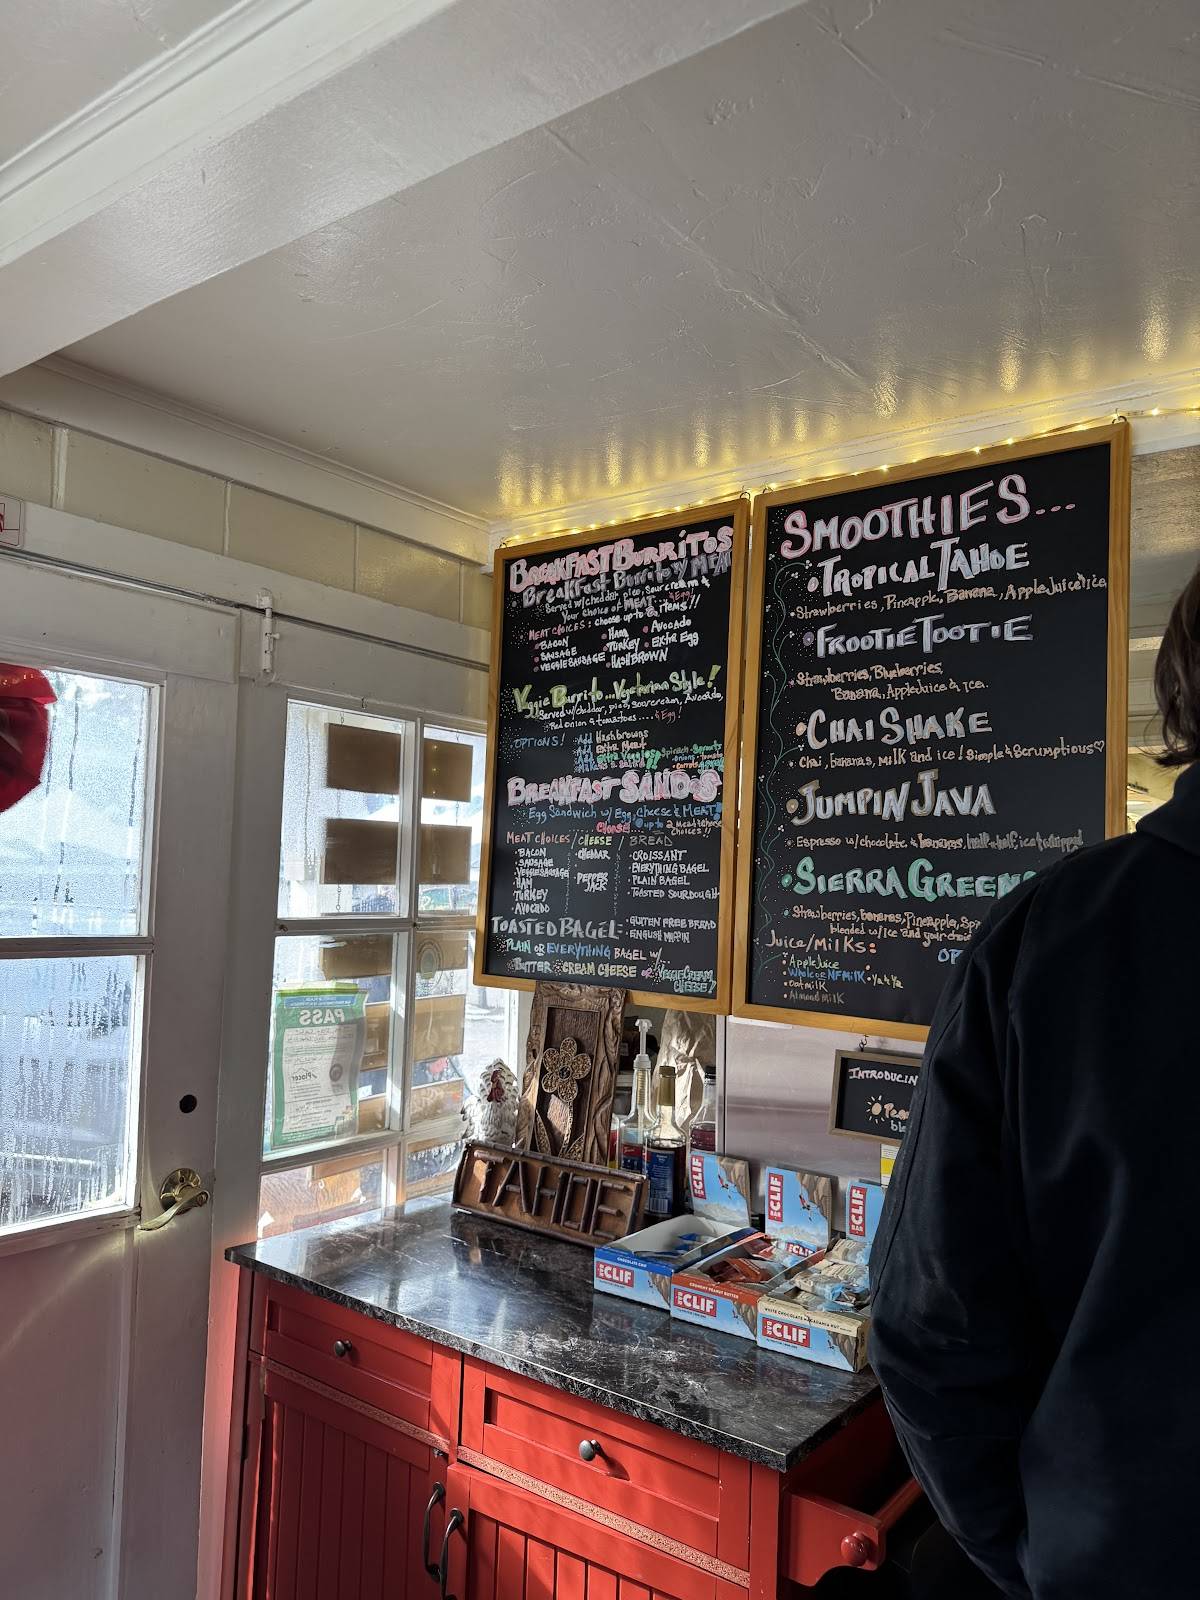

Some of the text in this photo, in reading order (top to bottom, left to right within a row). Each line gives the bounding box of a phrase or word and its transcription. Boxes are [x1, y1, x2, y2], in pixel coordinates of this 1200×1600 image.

[817, 537, 1030, 597] TROPICAL TAHOE
[1003, 578, 1046, 600] Apple
[545, 600, 572, 614] Served
[562, 599, 623, 624] Your choice of
[528, 627, 551, 640] MEAT
[606, 632, 699, 652] TURKEY Egg
[817, 613, 1033, 658] FROOTIE TOOTIE
[540, 636, 569, 650] BACON
[540, 647, 577, 661] SAUSAGE
[539, 703, 566, 720] Served
[549, 719, 563, 730] Red
[564, 720, 587, 728] onion
[807, 706, 993, 750] CHAI SHAKE
[909, 747, 932, 763] and
[966, 744, 1004, 763] Simple
[507, 775, 621, 806] BREAKFAST
[791, 768, 997, 826] JUMPIN JAVA
[528, 807, 547, 824] Egg
[548, 804, 597, 818] Sandwich
[507, 831, 612, 846] MEAT CHOICES CHEESE
[629, 835, 673, 847] BREAD
[796, 836, 842, 850] Espresso
[518, 848, 547, 858] BACON
[632, 849, 687, 861] CROISSANT
[518, 858, 554, 867] SAUSAGE
[680, 863, 709, 874] BAGEL
[577, 872, 608, 884] PEPPER
[632, 875, 690, 885] PLAIN BAGEL
[793, 856, 908, 899] SIERRA
[514, 888, 548, 902] TURKEY
[584, 882, 608, 892] JACK
[631, 887, 665, 897] TOASTED
[514, 902, 550, 915] AVOCADO
[491, 916, 557, 936] TOASTED
[663, 917, 687, 928] FREE
[830, 922, 865, 935] blended
[900, 928, 920, 939] and
[506, 938, 531, 953] PLAIN
[547, 943, 610, 960] EVERYTHING
[614, 947, 647, 960] BAGEL
[562, 961, 595, 976] CREAM
[597, 963, 637, 977] CHEESE
[789, 954, 816, 968] Apple
[692, 1157, 704, 1189] CLIF
[474, 1150, 629, 1240] TAHOE
[769, 1176, 782, 1211] CLIF
[851, 1188, 864, 1225] CLIF
[604, 1264, 632, 1284] CLIF
[682, 1293, 714, 1313] CLIF
[772, 1323, 807, 1344] CLIF
